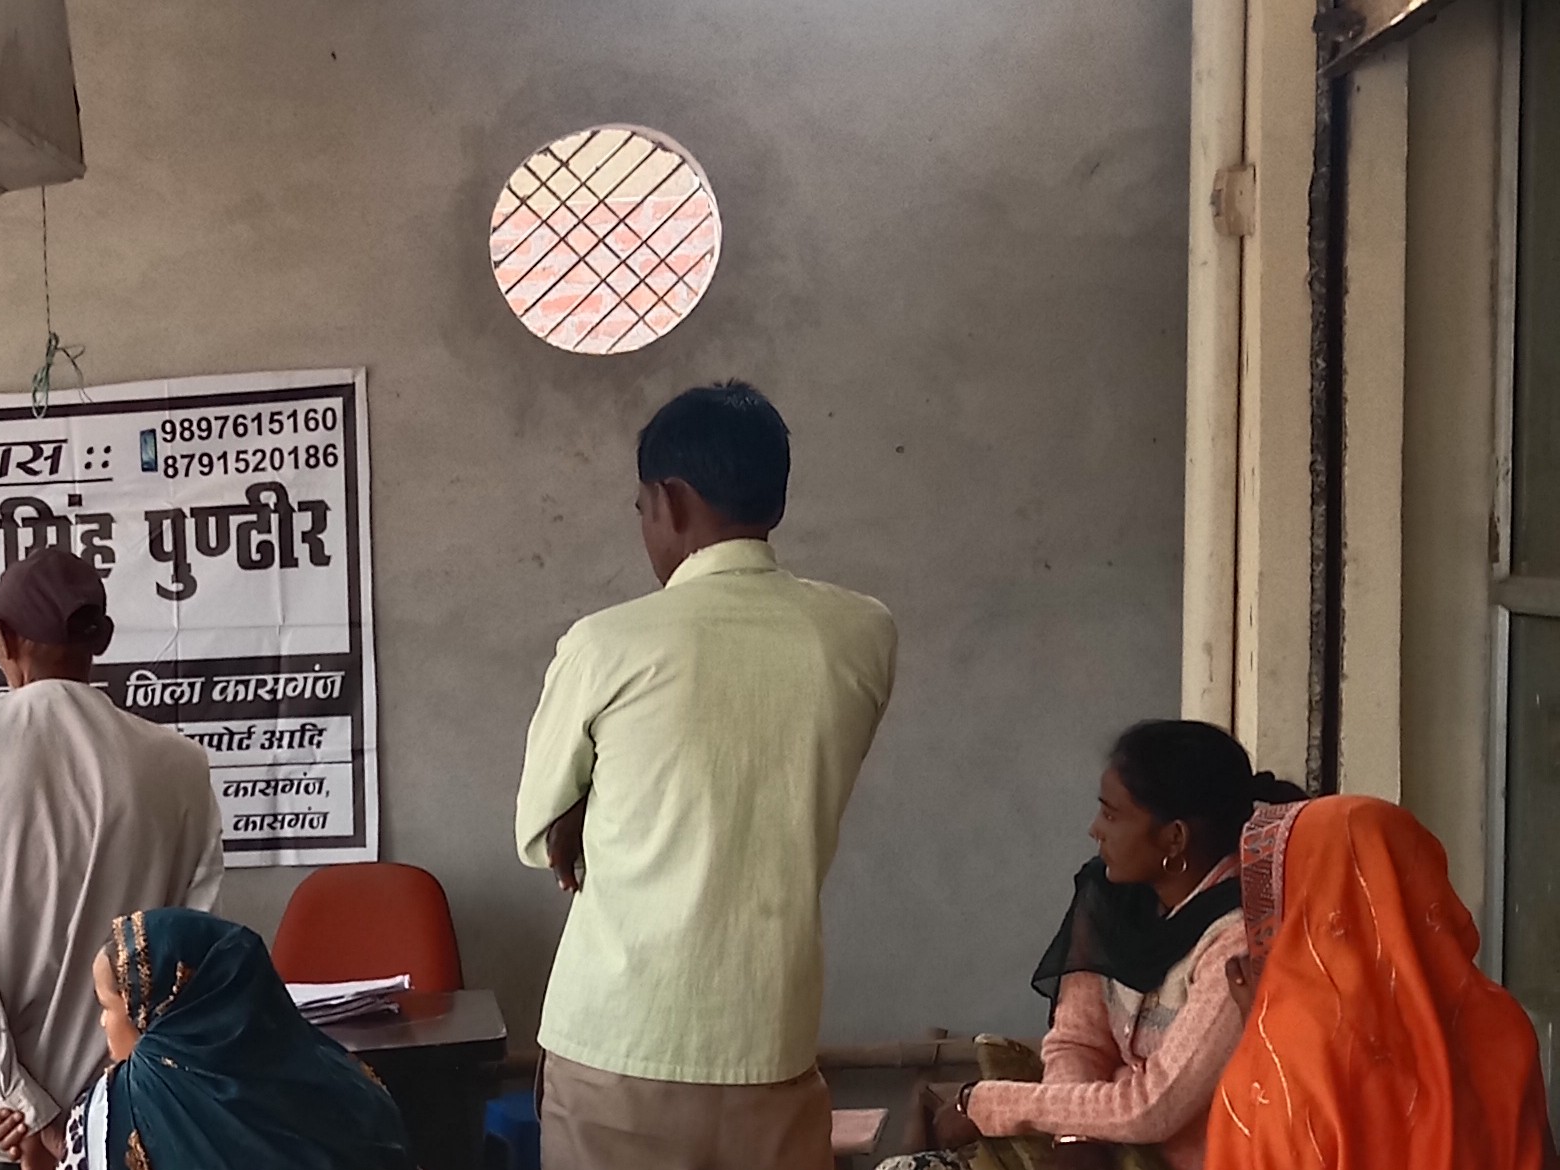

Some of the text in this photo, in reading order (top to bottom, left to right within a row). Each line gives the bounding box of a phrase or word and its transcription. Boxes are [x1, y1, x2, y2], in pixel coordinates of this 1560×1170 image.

[161, 406, 338, 444] 9897615160
[163, 443, 339, 480] 8791520186
[124, 668, 206, 709] जिला
[211, 662, 346, 705] कासगंज
[259, 722, 328, 752] आदि
[221, 771, 331, 799] कासगंज,
[232, 806, 331, 832] कासगंज
